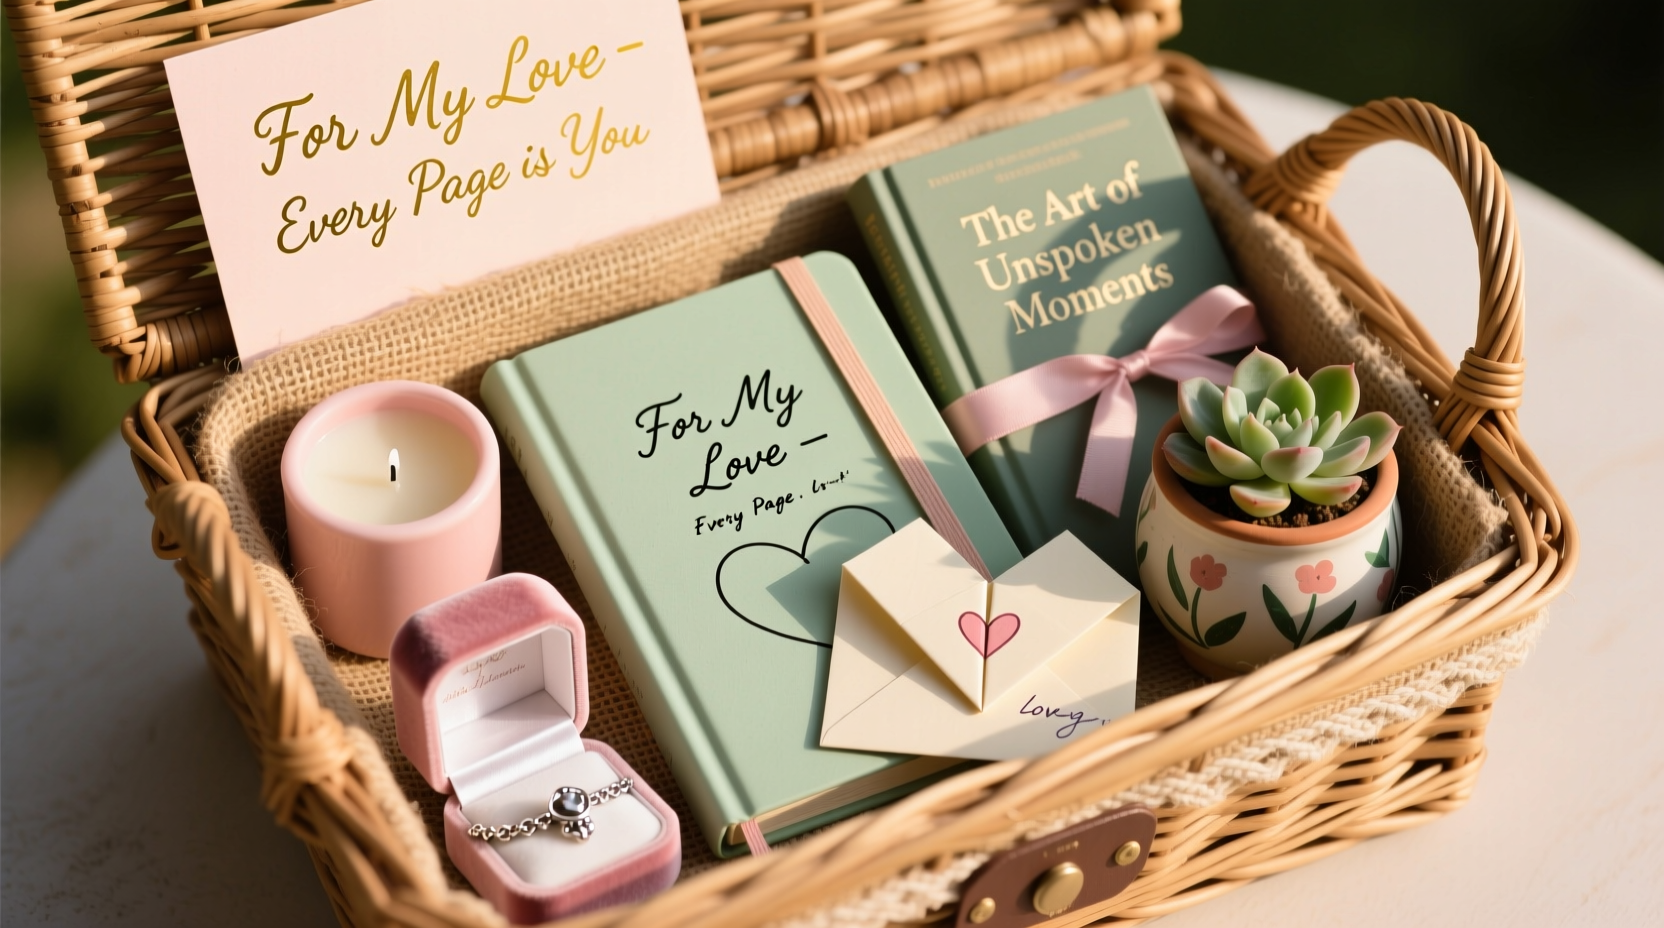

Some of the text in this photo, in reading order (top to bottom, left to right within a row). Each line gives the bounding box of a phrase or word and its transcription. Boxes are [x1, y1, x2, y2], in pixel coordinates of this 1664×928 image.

[253, 92, 359, 177] For
[371, 60, 475, 145] My
[486, 35, 606, 111] Love
[276, 106, 650, 254] Every Page is You
[960, 205, 1036, 248] The
[1045, 182, 1102, 226] Art
[1106, 160, 1144, 204] of
[974, 218, 1162, 291] Unspoken
[1004, 262, 1174, 335] Moments
[635, 369, 803, 458] For My
[689, 442, 787, 498] Love
